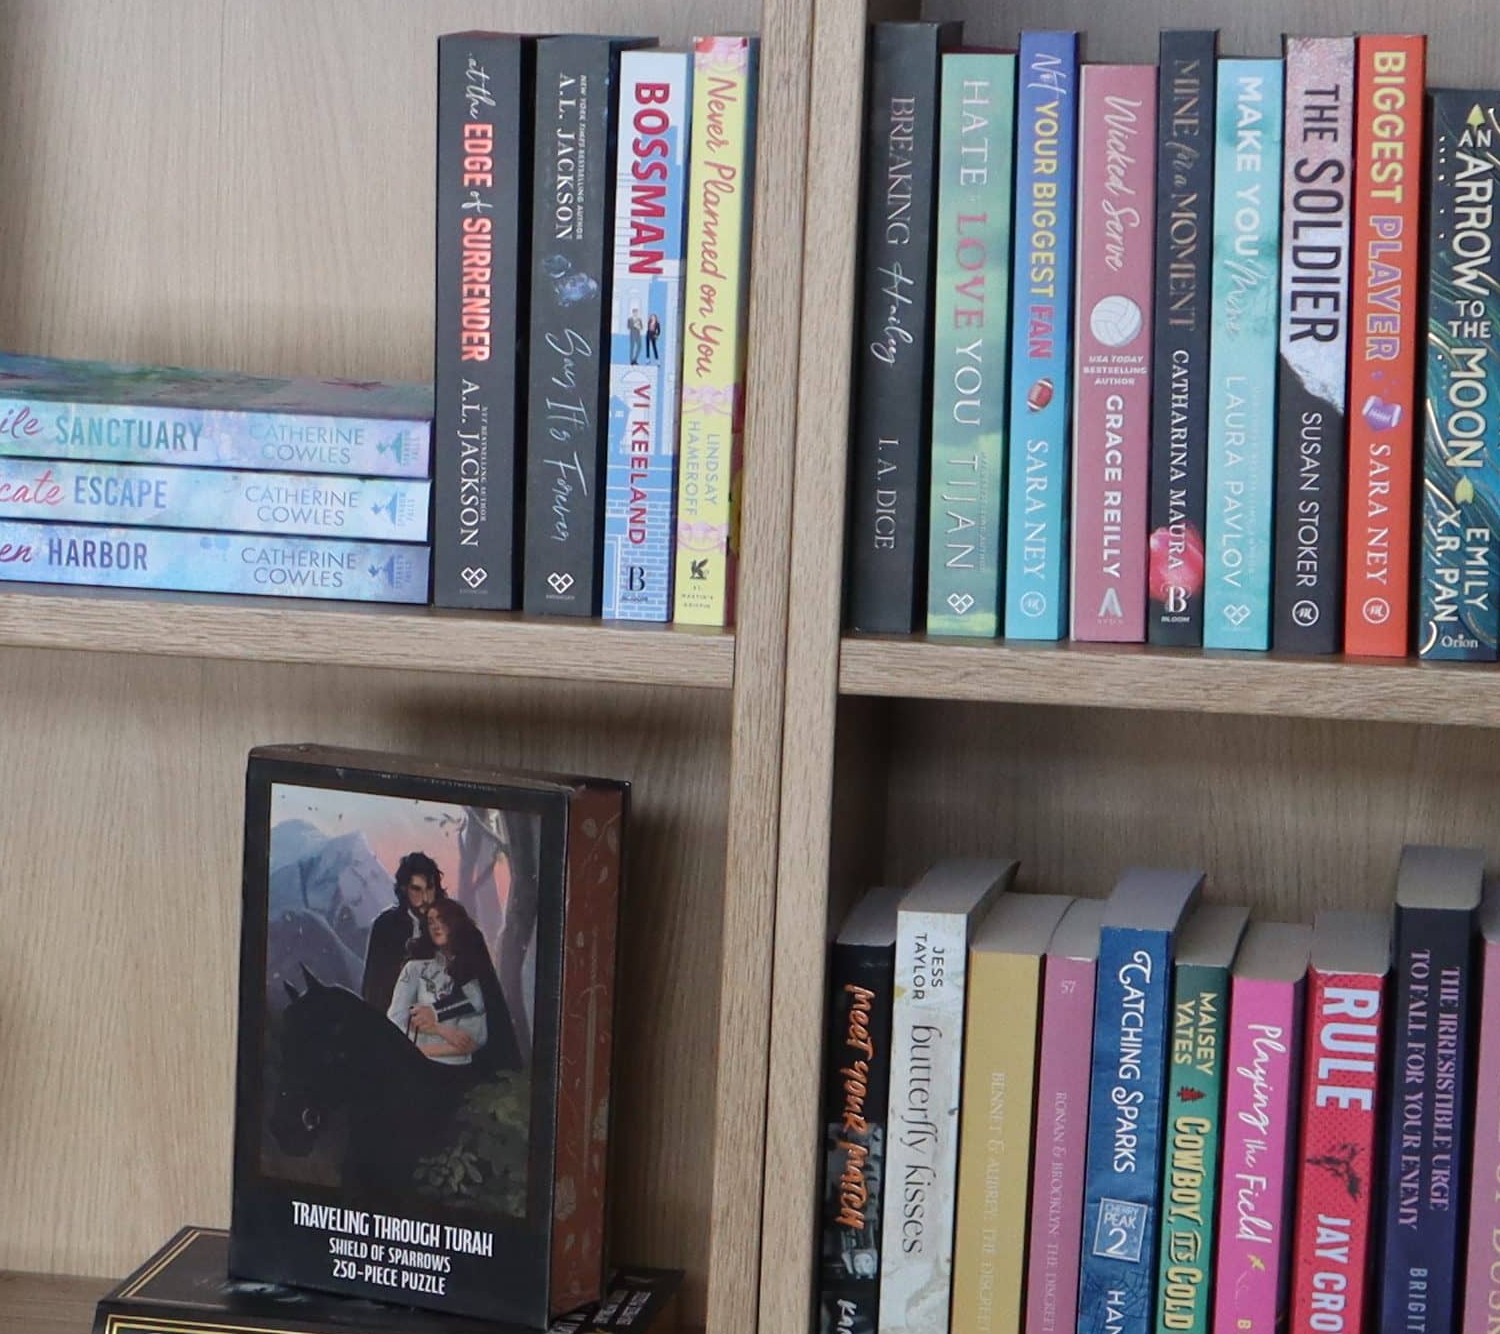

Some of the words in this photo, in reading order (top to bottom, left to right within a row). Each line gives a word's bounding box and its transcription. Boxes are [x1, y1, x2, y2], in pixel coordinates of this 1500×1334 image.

[579, 92, 587, 121] YORK
[957, 79, 990, 188] HATE
[1302, 82, 1340, 144] THE
[1369, 50, 1406, 206] BIGGEST
[461, 121, 494, 189] EDGE
[577, 147, 586, 203] BESTSELLING
[629, 82, 670, 275] BOSSMAN
[468, 193, 494, 217] of
[458, 215, 492, 363] SURRENDER
[951, 210, 987, 331] LOVE
[1287, 156, 1343, 345] SOLDIER
[1364, 214, 1405, 362] PLAYER
[632, 384, 651, 409] VI
[949, 336, 983, 428] YOU
[1088, 355, 1109, 363] USA
[1111, 355, 1143, 363] TODAY
[54, 417, 204, 453] SANCTUARY
[250, 424, 365, 445] CATHERINE
[1103, 394, 1125, 485] GRACE
[1298, 411, 1323, 478] SUSAN
[628, 420, 650, 545] KEELAND
[1101, 490, 1123, 580] REILLY
[1295, 483, 1320, 589] STOKER
[1316, 986, 1380, 1112] RULE
[292, 1201, 370, 1236] TRAVELING
[373, 1214, 440, 1248] THROUGH
[444, 1226, 493, 1257] TURAH
[329, 1237, 368, 1259] SHIELD
[370, 1246, 385, 1262] OF
[388, 1247, 451, 1273] SPARROWS
[1317, 1213, 1351, 1265] JAY
[332, 1258, 398, 1287] 250-PIECE
[401, 1271, 446, 1296] PUZZLE
